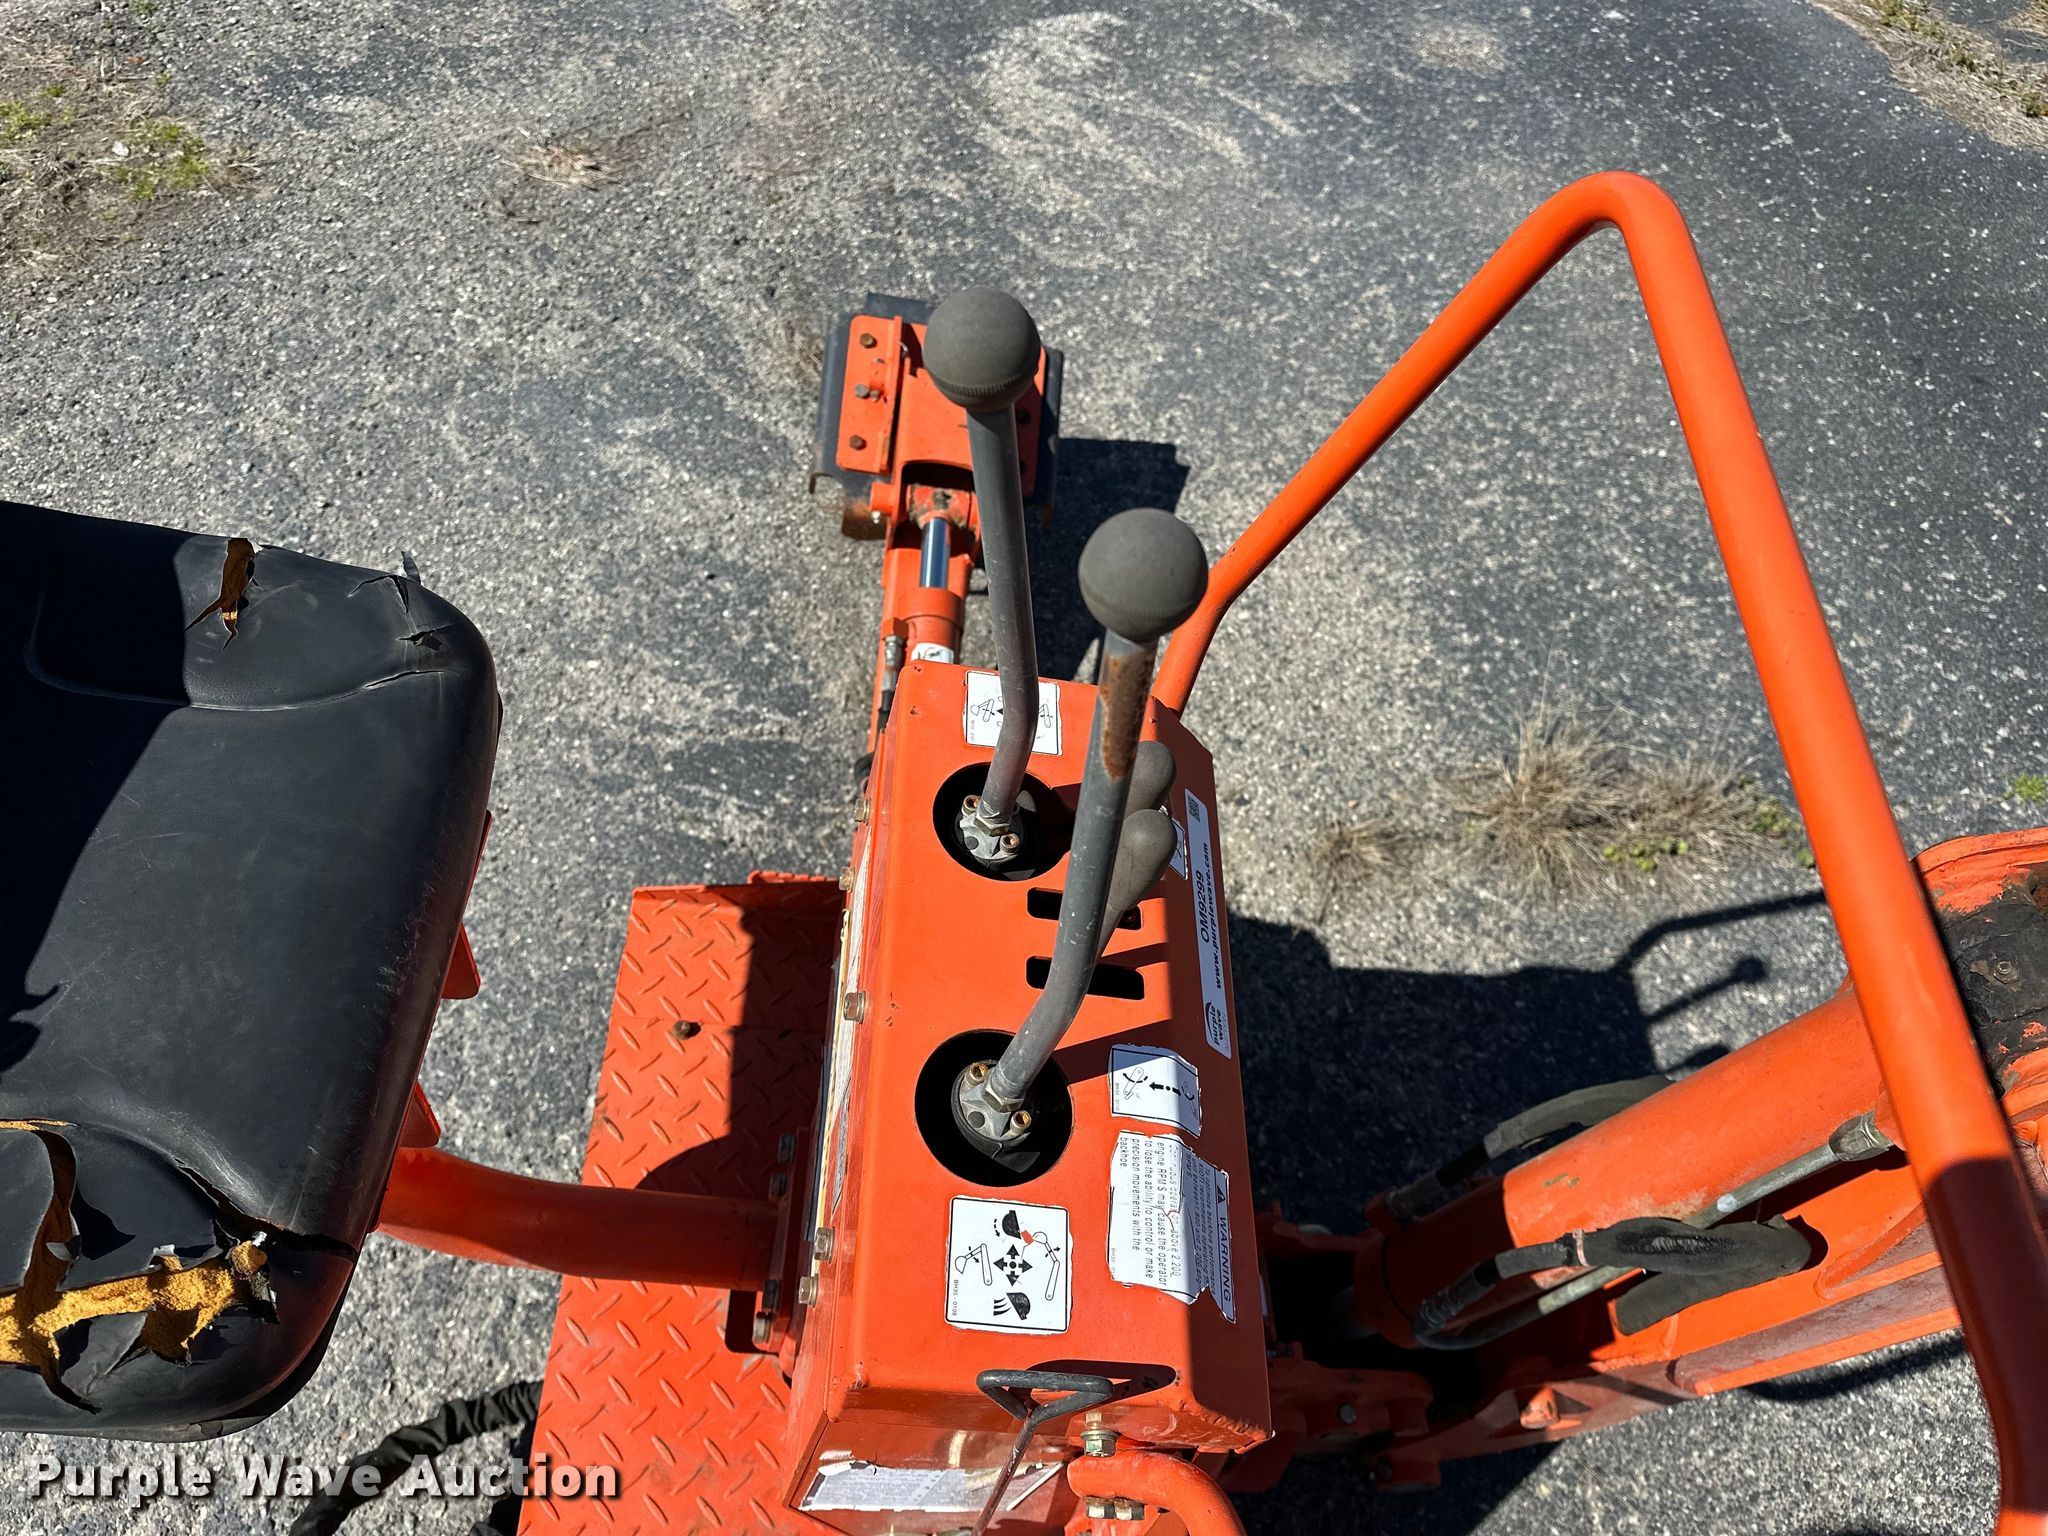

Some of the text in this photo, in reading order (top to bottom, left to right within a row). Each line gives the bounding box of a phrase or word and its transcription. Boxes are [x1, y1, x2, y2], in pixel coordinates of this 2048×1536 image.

[1195, 870, 1209, 943] OM9299
[1203, 842, 1221, 989] www.purplewave.com
[1210, 1005, 1220, 1046] purple
[1145, 1149, 1153, 1165] lose
[1155, 1142, 1165, 1166] engine
[1145, 1167, 1154, 1179] the
[1132, 1138, 1142, 1251] precision movements with the
[1143, 1180, 1154, 1204] ability
[1145, 1207, 1153, 1215] to
[1145, 1217, 1154, 1245] control
[1157, 1213, 1166, 1236] cause
[1145, 1247, 1153, 1256] or
[1158, 1238, 1168, 1250] the
[1145, 1257, 1155, 1279] make
[1156, 1253, 1167, 1286] operator
[1220, 1217, 1231, 1302] WARNING
